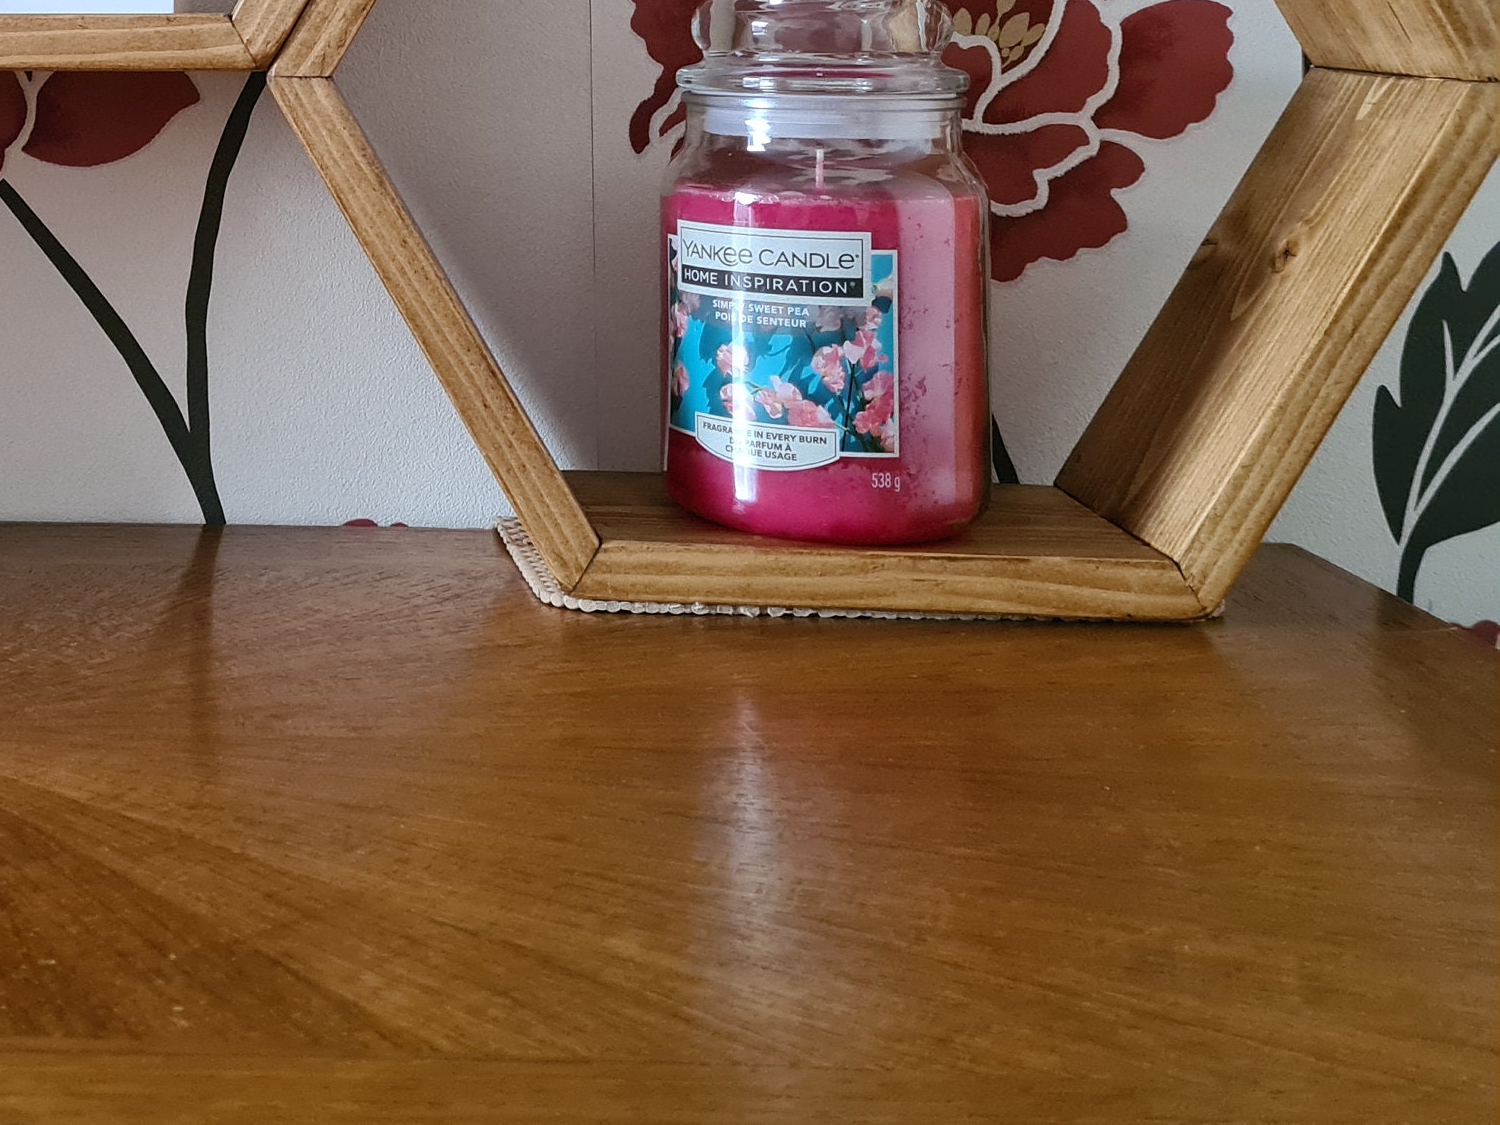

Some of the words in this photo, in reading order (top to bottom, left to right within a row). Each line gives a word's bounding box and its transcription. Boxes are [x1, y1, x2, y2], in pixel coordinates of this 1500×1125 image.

[684, 267, 719, 286] HOME
[724, 273, 848, 294] INSPIRATION
[748, 303, 785, 316] SWEET
[787, 306, 810, 317] PEA
[741, 314, 754, 324] DE
[756, 315, 808, 329] SENTEUR
[702, 421, 751, 438] FRAGRAE
[754, 430, 764, 440] IN
[765, 432, 797, 443] EVERY
[798, 435, 827, 445] BURN
[764, 451, 798, 462] USAGE
[871, 472, 892, 489] 538
[894, 475, 901, 492] g
